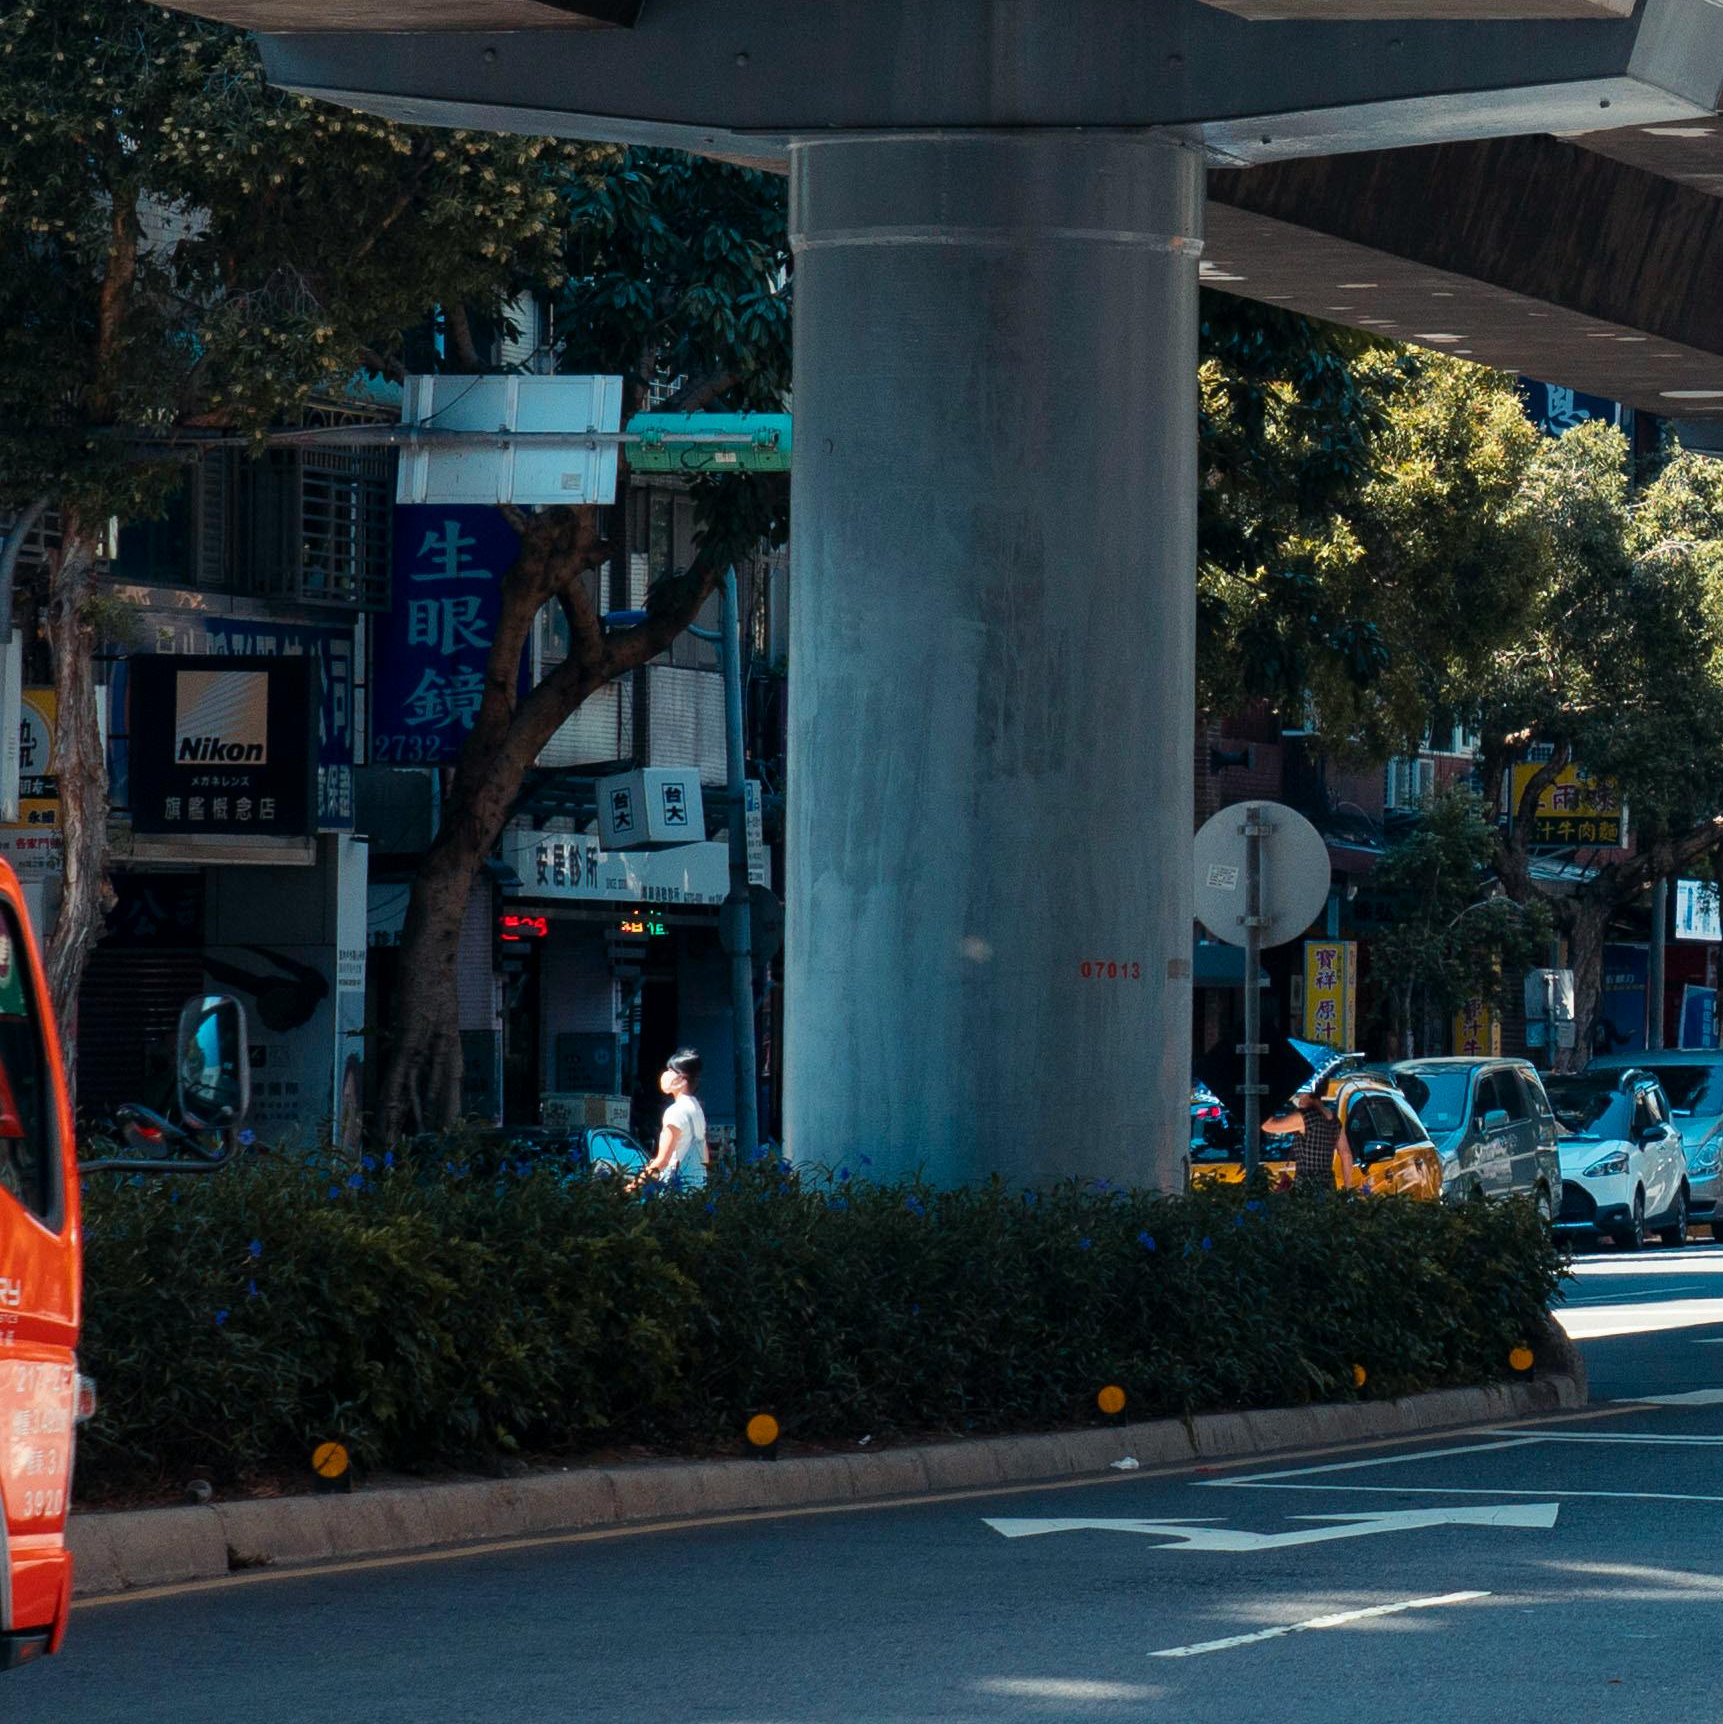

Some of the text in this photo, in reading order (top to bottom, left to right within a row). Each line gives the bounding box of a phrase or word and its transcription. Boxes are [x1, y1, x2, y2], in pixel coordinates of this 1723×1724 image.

[403, 520, 493, 731] 生眼鏡
[178, 737, 264, 762] Nikon
[614, 794, 631, 828] 台大
[665, 787, 684, 822] 台大
[1080, 960, 1141, 980] 07013
